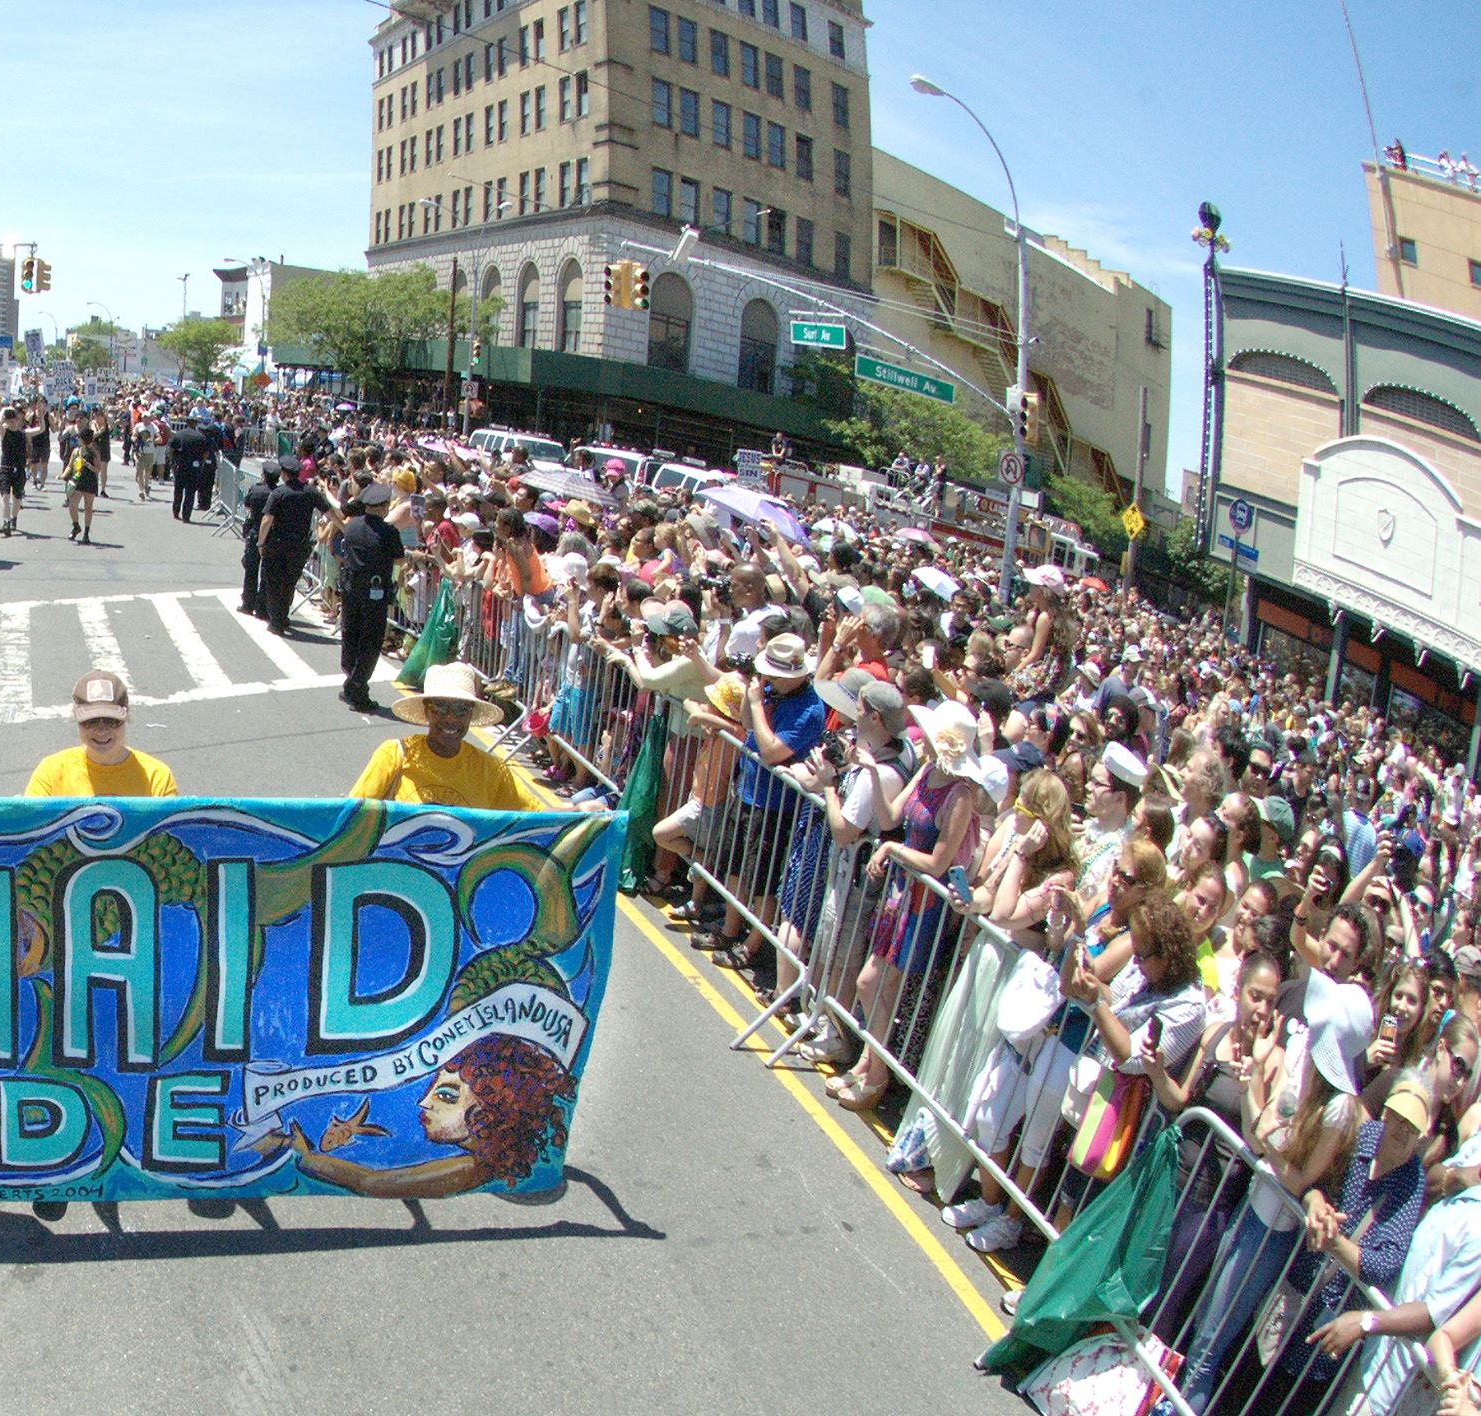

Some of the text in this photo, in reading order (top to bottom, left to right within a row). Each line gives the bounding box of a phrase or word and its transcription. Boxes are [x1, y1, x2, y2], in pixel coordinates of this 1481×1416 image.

[803, 328, 818, 340] Surf
[875, 366, 937, 394] Stillwell Av
[739, 469, 758, 478] SIN
[253, 1065, 378, 1106] PRODUCED
[393, 1055, 416, 1076] BY
[52, 1184, 104, 1199] 2004
